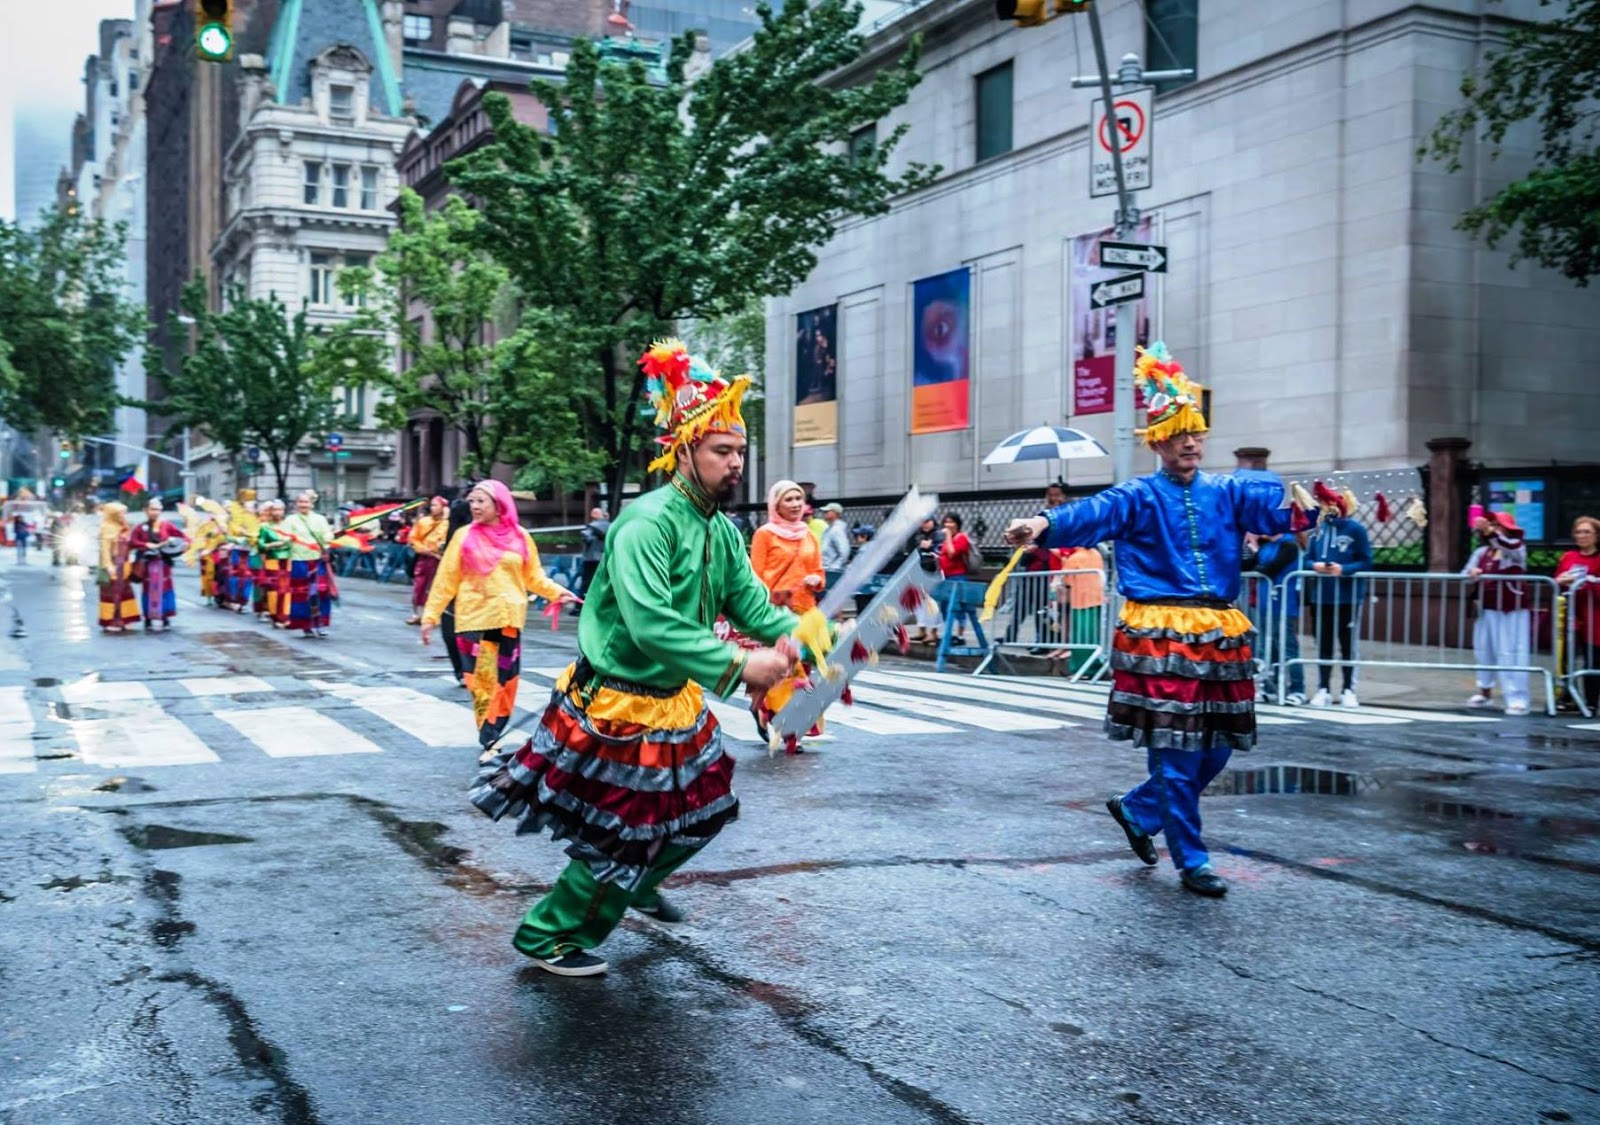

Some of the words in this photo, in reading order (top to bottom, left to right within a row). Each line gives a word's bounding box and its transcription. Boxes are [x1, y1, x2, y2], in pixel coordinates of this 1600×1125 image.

[1109, 249, 1129, 262] ONE
[1138, 252, 1157, 263] WAY
[1097, 286, 1113, 300] ONE
[1121, 281, 1137, 292] WAY
